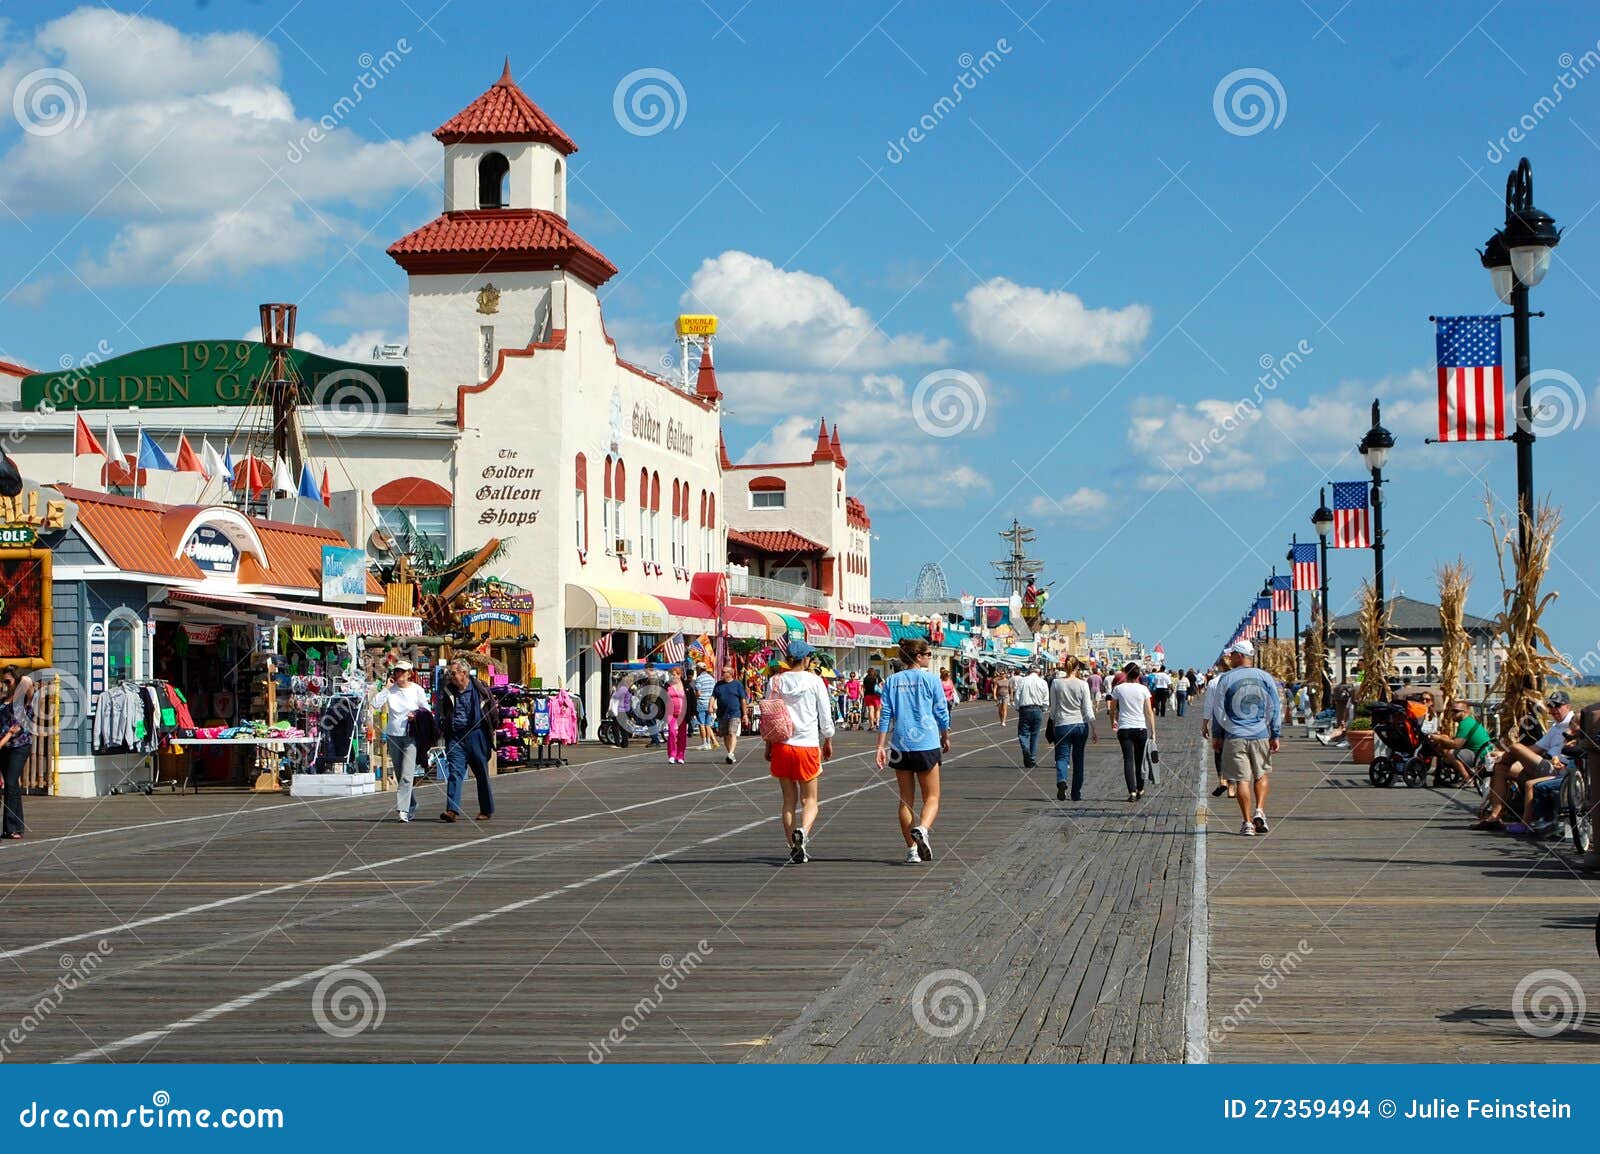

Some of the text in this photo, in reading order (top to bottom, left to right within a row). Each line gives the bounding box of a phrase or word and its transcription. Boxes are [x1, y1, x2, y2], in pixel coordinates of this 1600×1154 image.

[684, 318, 713, 326] DOUBLE
[180, 342, 252, 372] 1929
[43, 374, 192, 404] GOLDEN
[631, 401, 661, 446] Golden
[498, 448, 518, 459] The
[481, 465, 535, 479] Golden
[475, 485, 542, 501] Galleon
[477, 508, 540, 527] Shops
